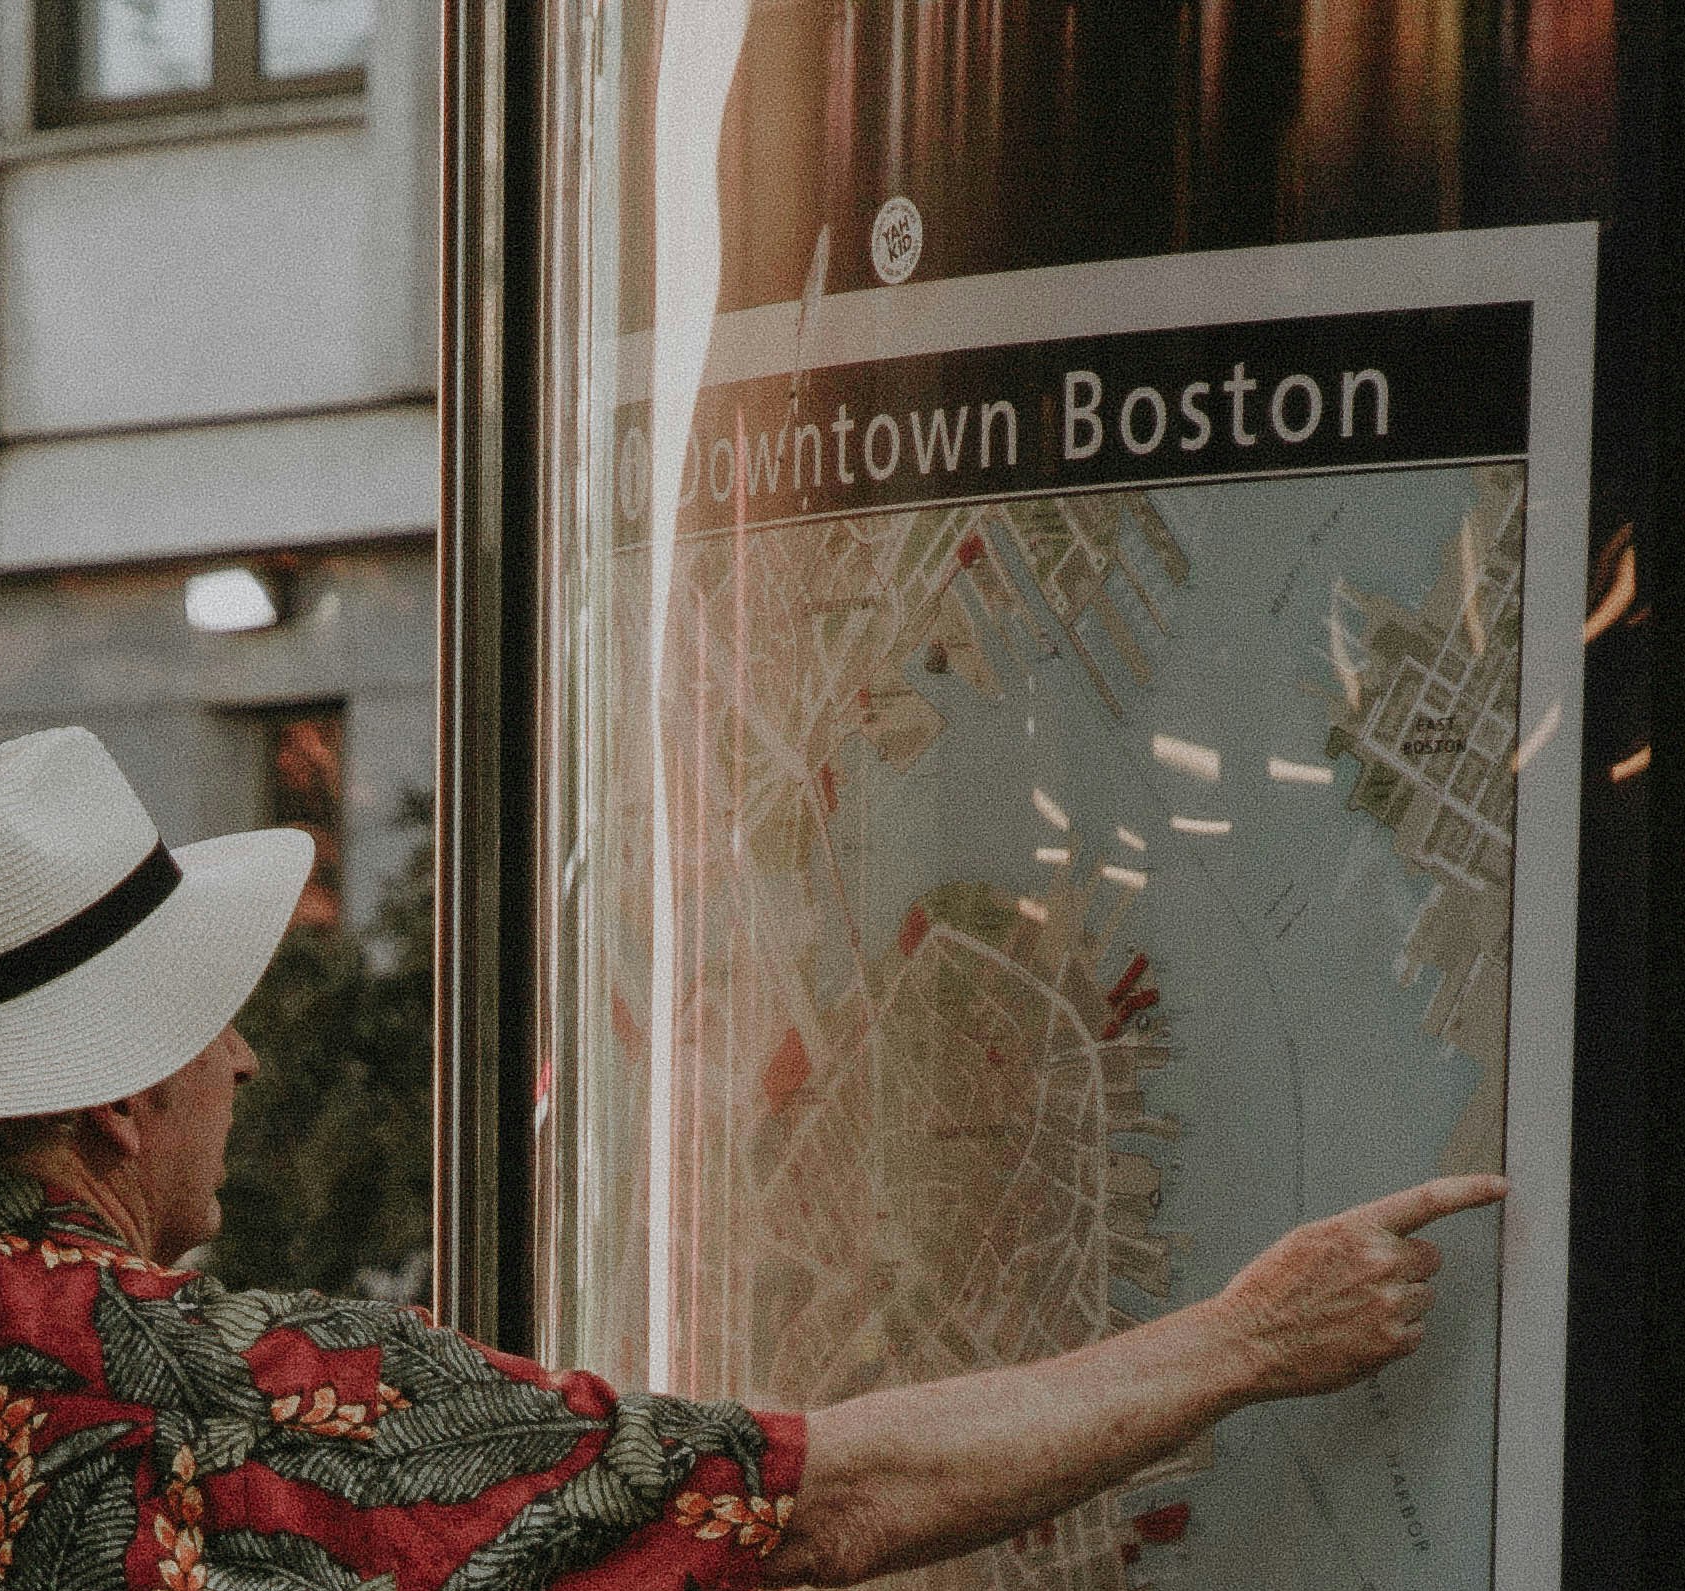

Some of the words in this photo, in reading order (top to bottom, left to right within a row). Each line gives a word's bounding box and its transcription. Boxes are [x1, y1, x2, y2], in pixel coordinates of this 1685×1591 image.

[1063, 362, 1390, 460] Boston
[1416, 714, 1456, 732] EAST
[1403, 738, 1467, 755] BOSTON
